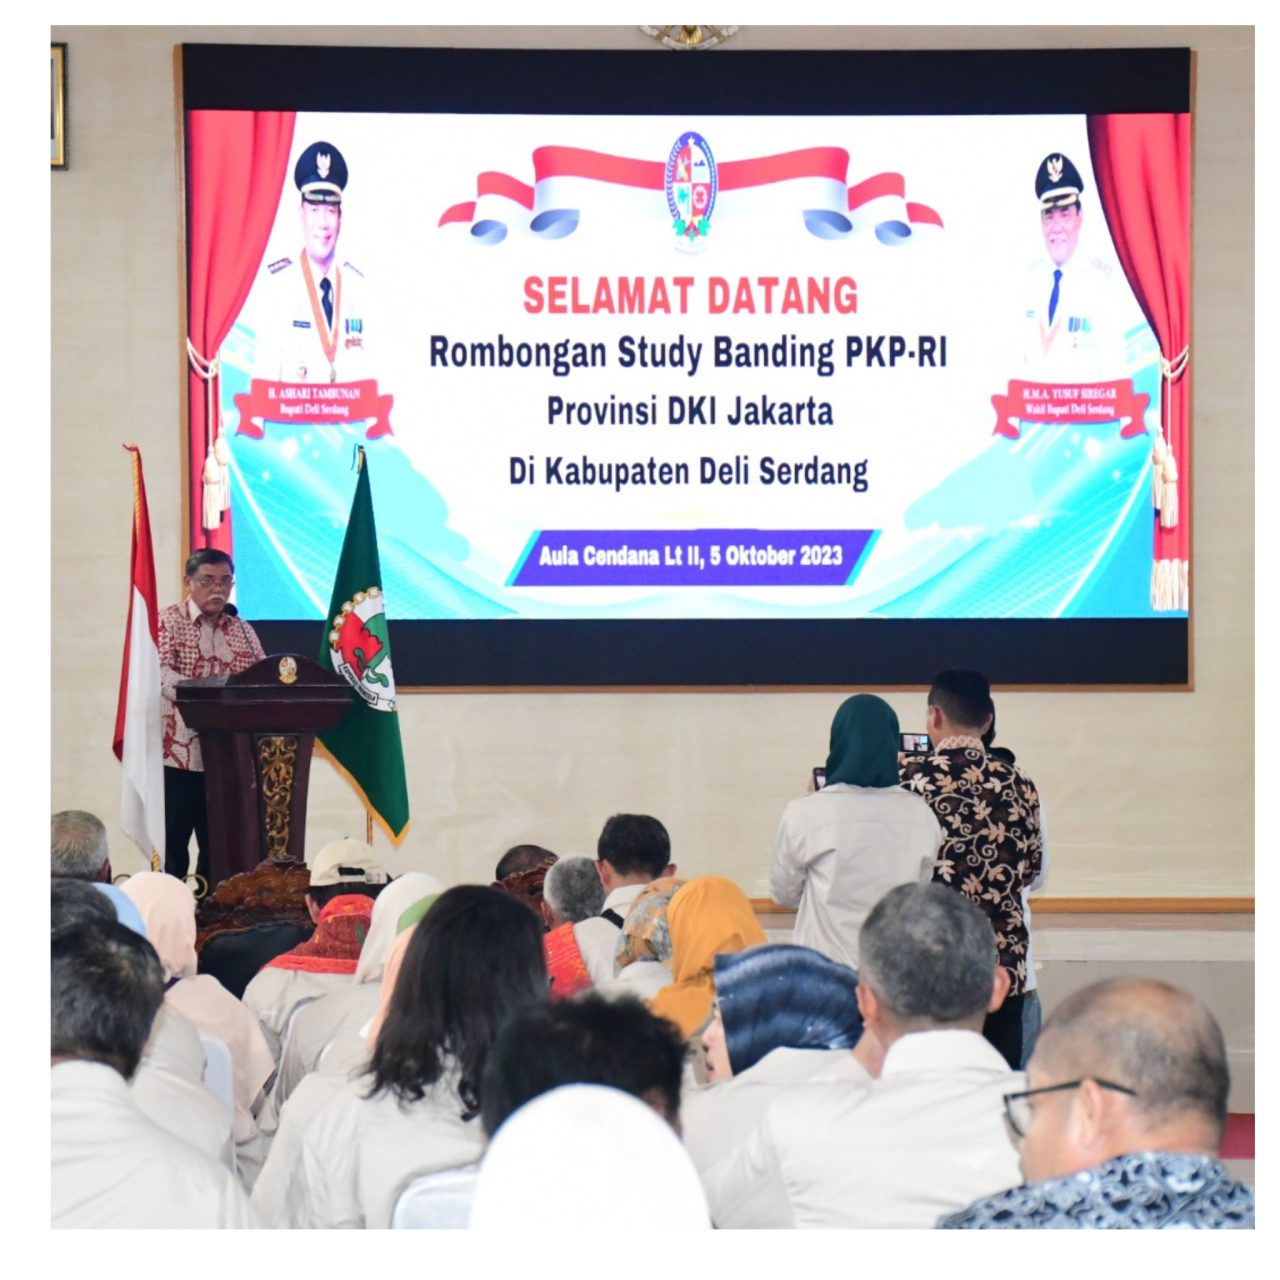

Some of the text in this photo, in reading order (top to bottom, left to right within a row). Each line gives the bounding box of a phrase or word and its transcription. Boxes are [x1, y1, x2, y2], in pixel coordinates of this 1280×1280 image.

[524, 276, 857, 314] SELAMAT DATANG
[431, 334, 946, 376] Rombongan Study Banding PKP-RI
[548, 395, 833, 425] Provinsi DKI Jakarta
[510, 456, 868, 492] Di Kabupaten Deli Serdang
[540, 545, 842, 569] Aula Cendana Lt II, 5 Oktober 2023
